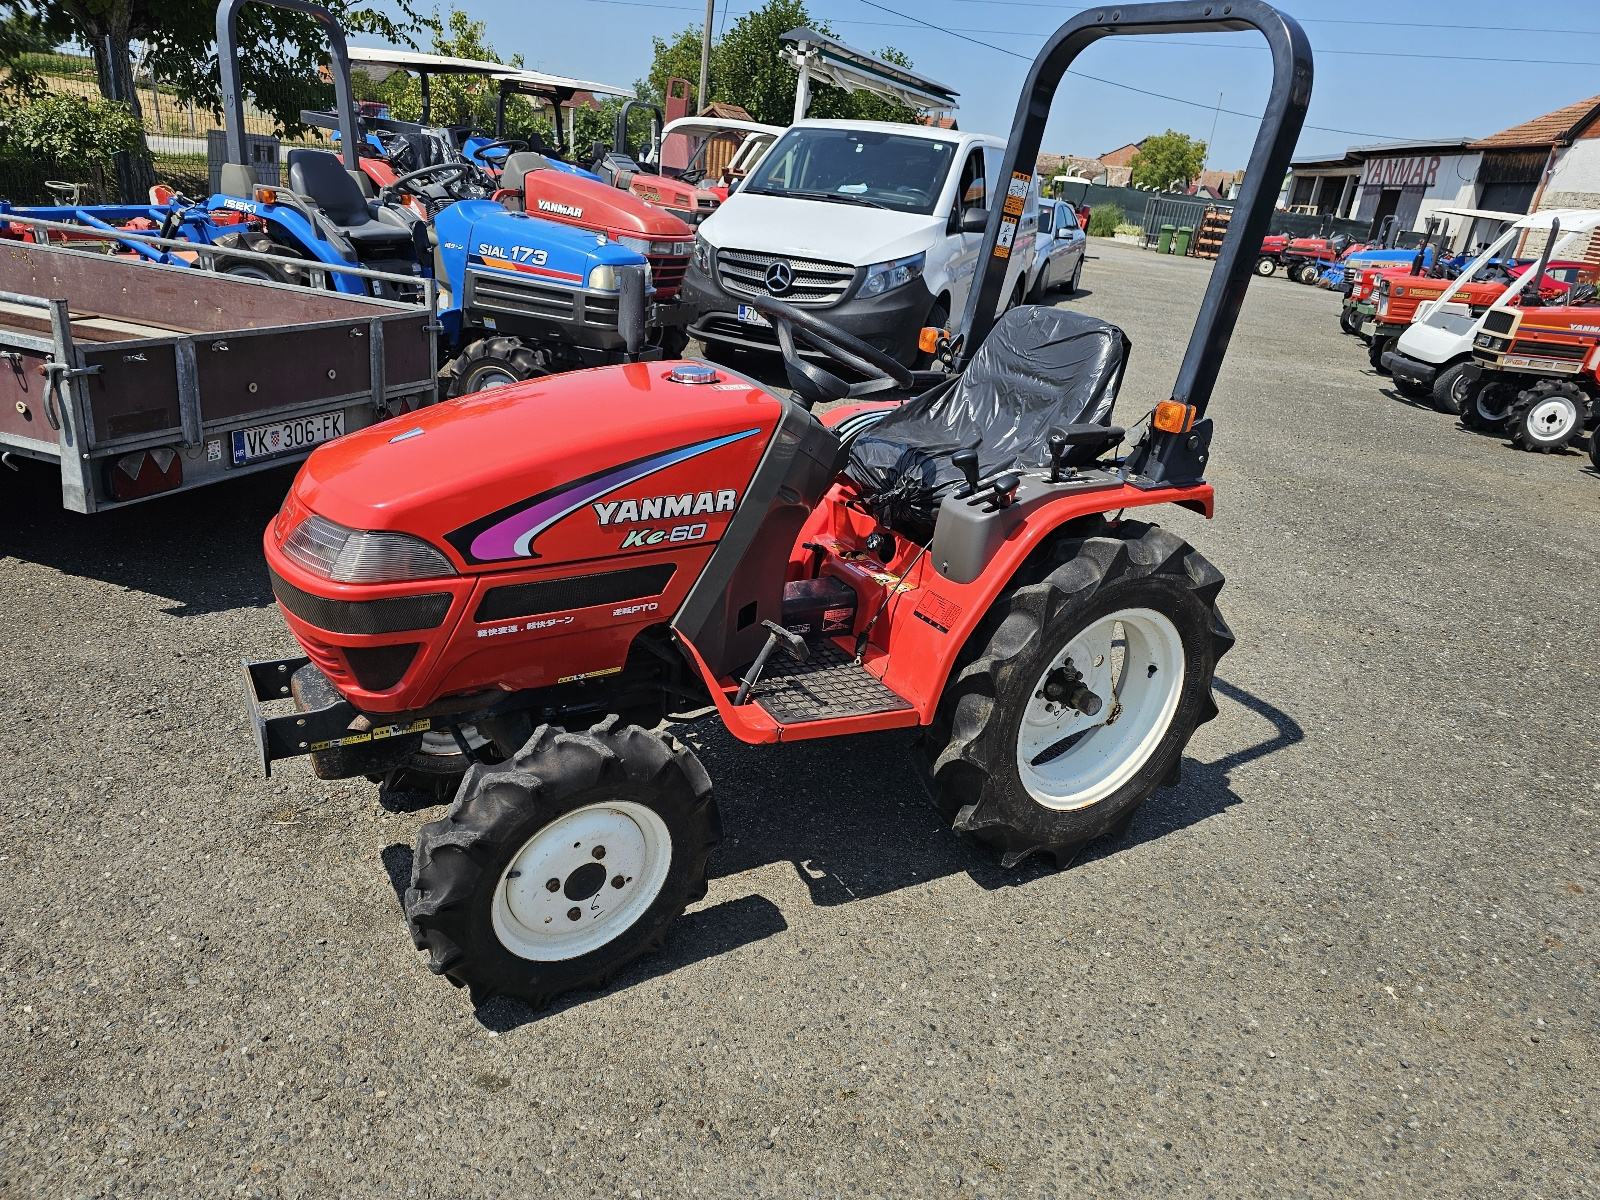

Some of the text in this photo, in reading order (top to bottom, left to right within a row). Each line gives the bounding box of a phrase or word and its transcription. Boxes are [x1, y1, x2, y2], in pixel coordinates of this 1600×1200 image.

[1366, 156, 1441, 184] YANMAR
[224, 199, 256, 214] ISEKI
[537, 199, 583, 218] YANMAR
[478, 243, 549, 266] SIAL 173
[1569, 323, 1600, 333] YANM
[247, 429, 270, 456] VK
[283, 414, 342, 449] 306-FK
[235, 449, 245, 459] HR
[592, 488, 738, 526] YANMAR
[619, 522, 709, 550] Ke-60
